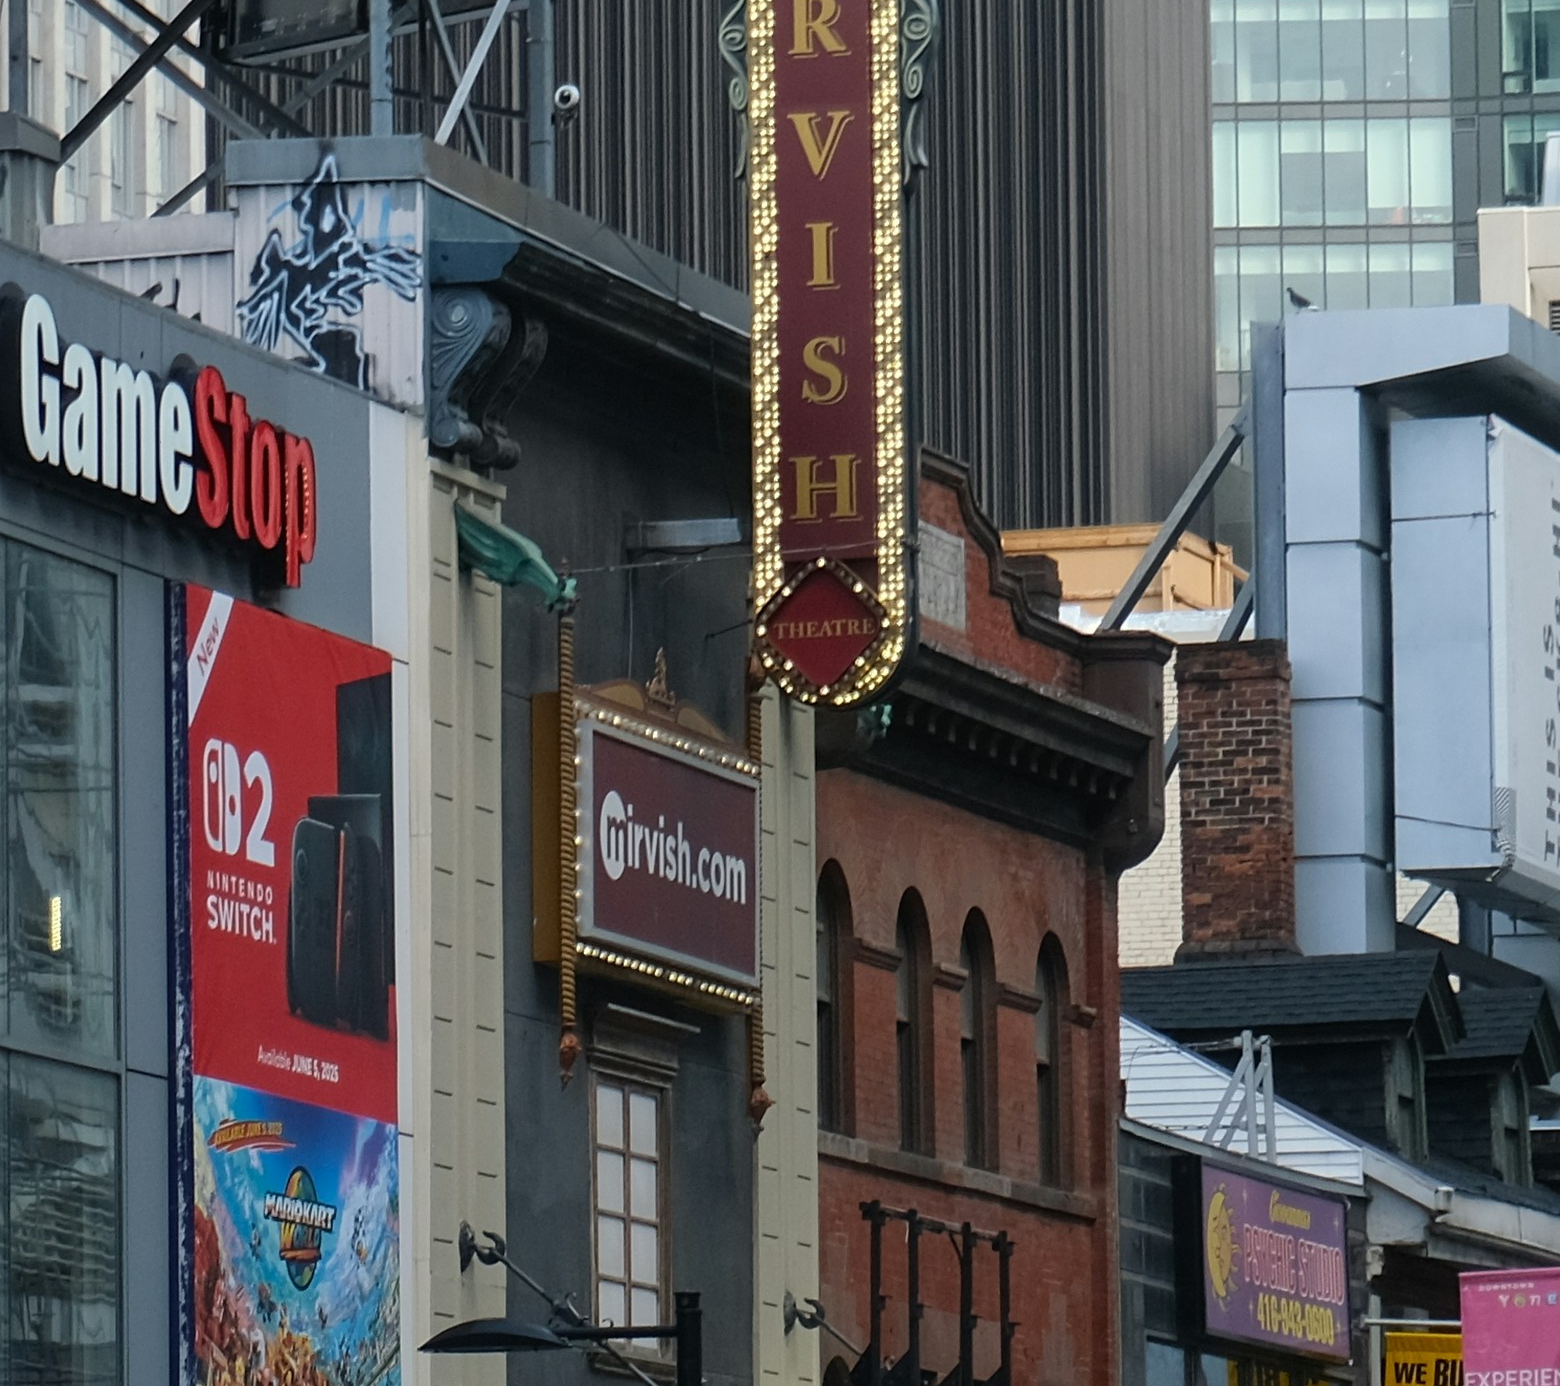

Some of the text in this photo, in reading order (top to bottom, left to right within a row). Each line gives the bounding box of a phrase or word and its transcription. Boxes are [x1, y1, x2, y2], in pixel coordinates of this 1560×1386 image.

[20, 293, 316, 589] GameStop
[194, 617, 223, 676] New
[773, 618, 876, 641] THEATRE
[1542, 624, 1556, 862] THIS IS
[246, 760, 275, 867] 2
[600, 789, 746, 905] mirvish.com
[207, 870, 273, 905] NINTENDO
[257, 1045, 291, 1072] Available
[292, 1053, 313, 1075] JUNE
[215, 1124, 245, 1145] AVAILABLE
[1243, 1223, 1345, 1306] PSYCHIC STUDIO
[1394, 1362, 1428, 1385] WE
